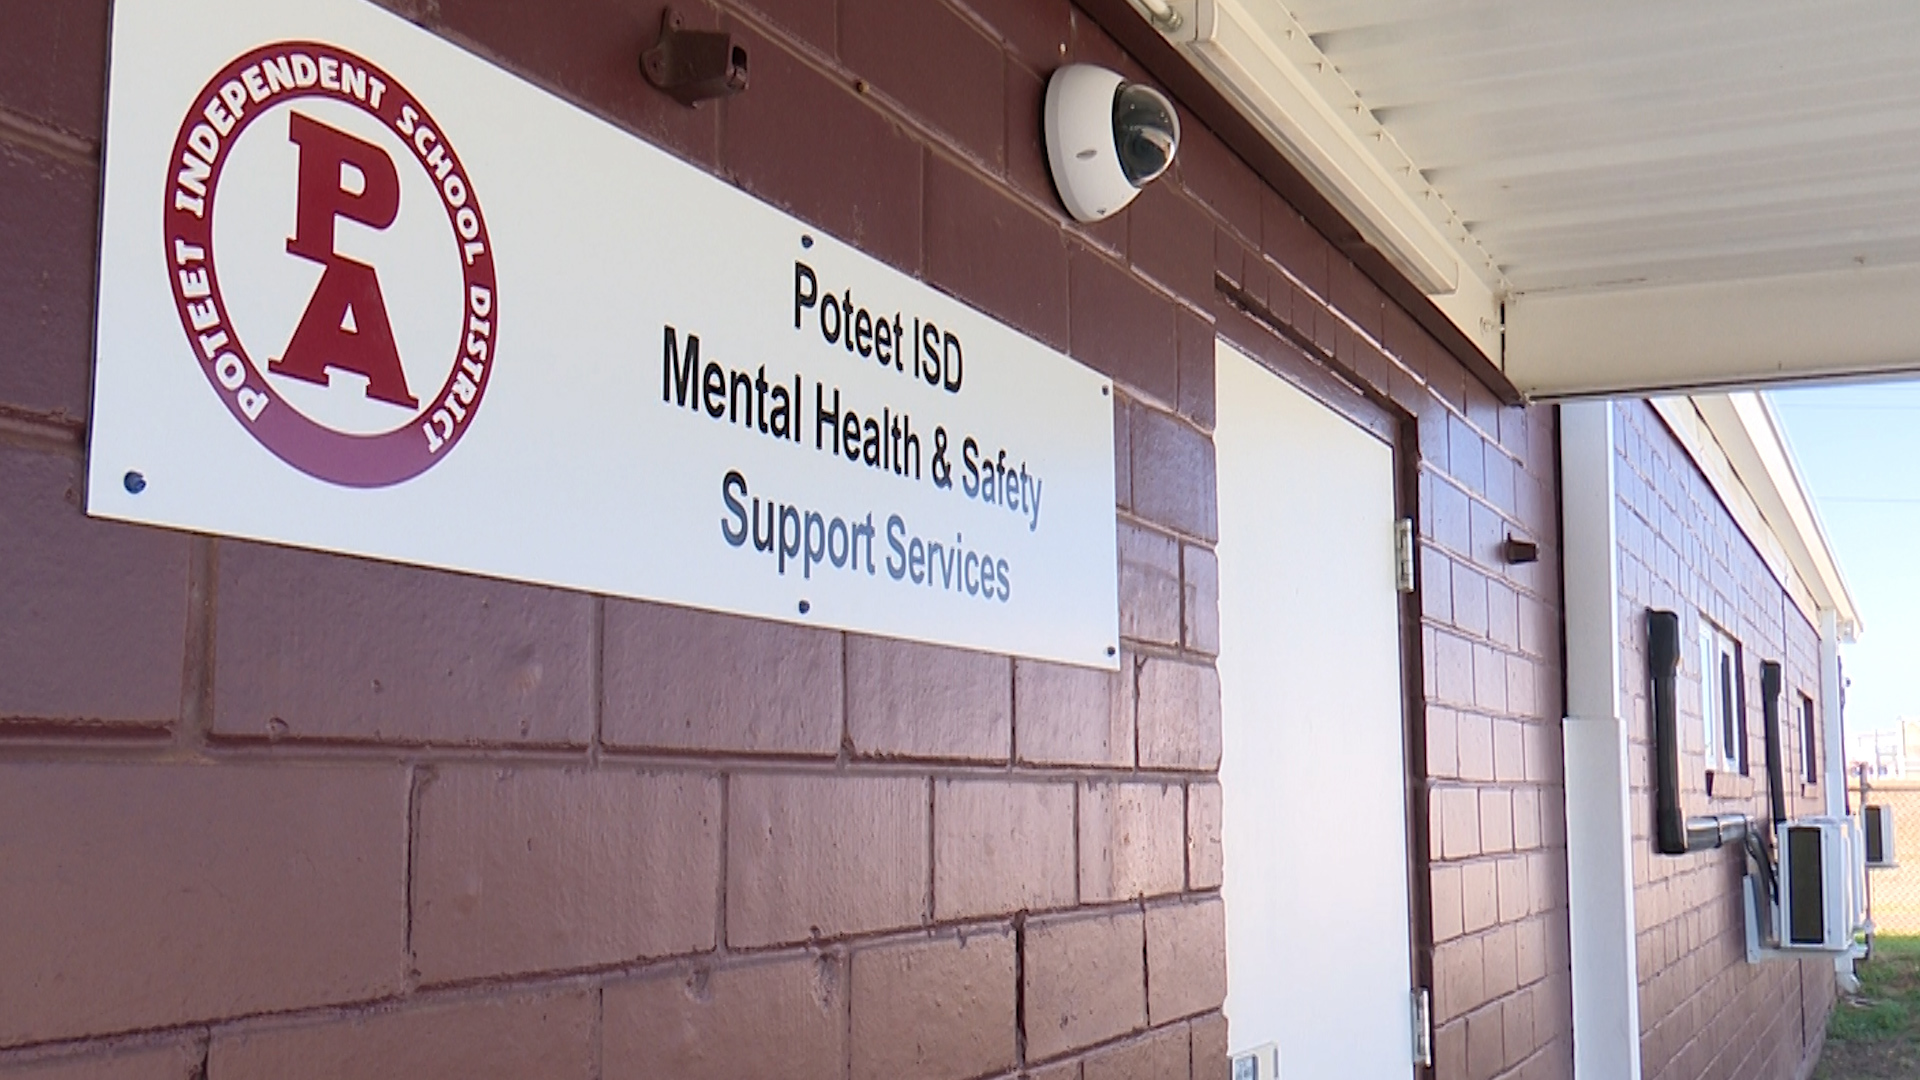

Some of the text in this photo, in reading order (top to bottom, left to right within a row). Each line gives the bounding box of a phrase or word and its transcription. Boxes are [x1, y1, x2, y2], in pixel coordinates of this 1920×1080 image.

[175, 53, 491, 453] POTEET INDEPENDENT SCHOOL DISTRICT
[794, 260, 963, 393] Poteet ISD
[663, 325, 1042, 531] Mental Health & Safety
[721, 470, 1011, 602] Support Services
